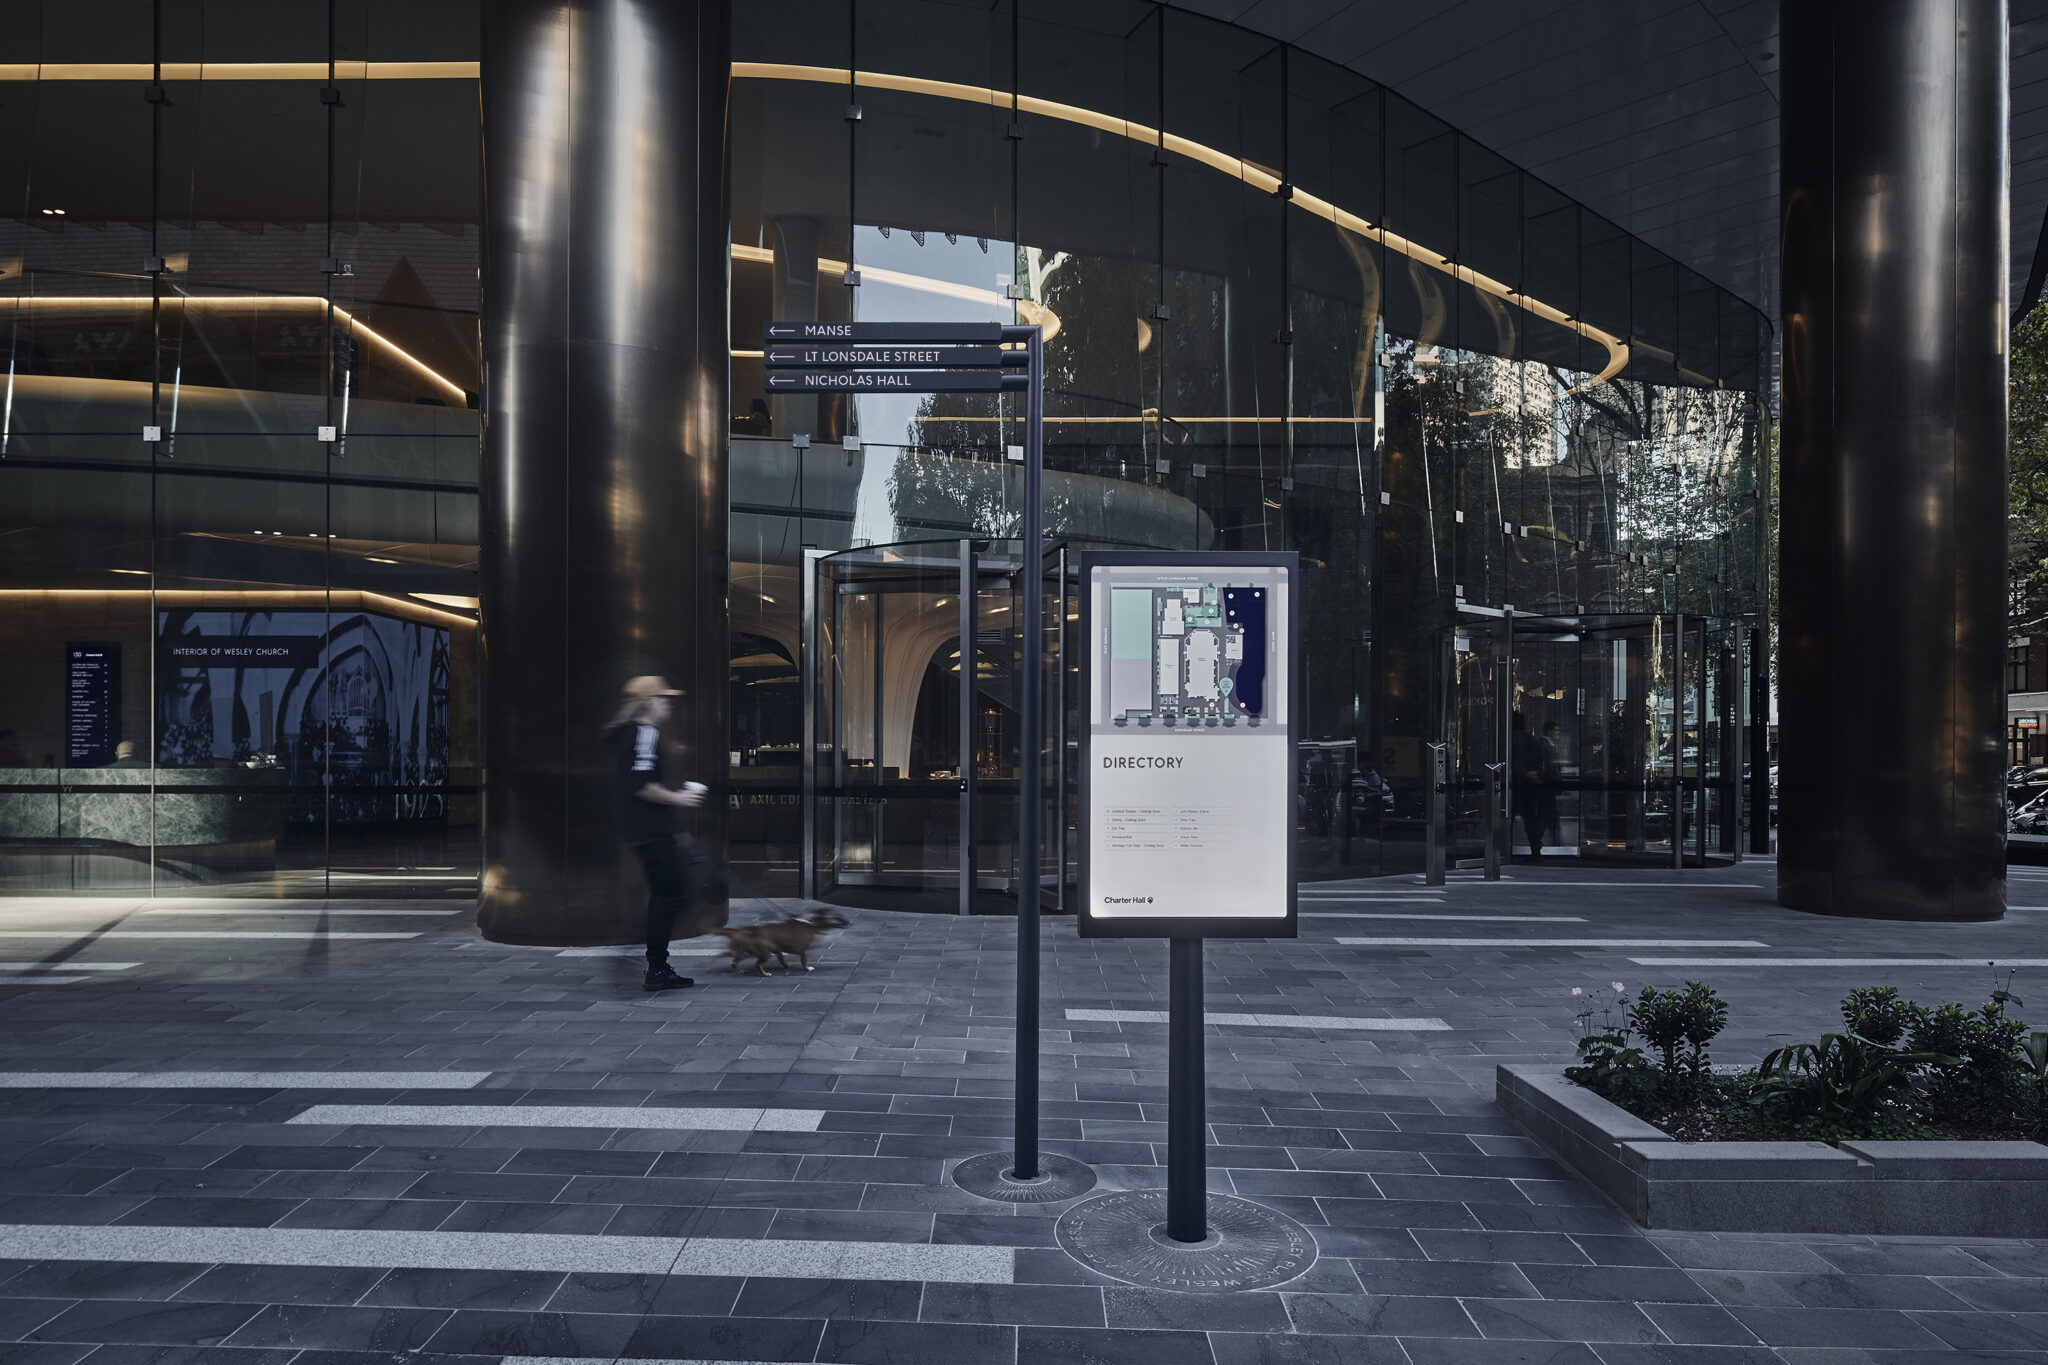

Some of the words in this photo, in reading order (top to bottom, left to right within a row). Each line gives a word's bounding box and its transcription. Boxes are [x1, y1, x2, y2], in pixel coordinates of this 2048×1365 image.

[805, 325, 852, 337] MANSE
[805, 350, 819, 363] LT
[822, 350, 890, 363] LONSDALE
[894, 350, 941, 363] STREET
[805, 374, 873, 387] NICHOLAS
[877, 374, 912, 387] HALL
[173, 647, 208, 656] INTERIOR
[210, 647, 222, 656] OF
[224, 647, 254, 656] WESLEY
[256, 647, 289, 656] CHURCH
[1103, 756, 1184, 769] DIRECTORY
[750, 794, 777, 806] AXIL
[1104, 896, 1132, 904] Charter
[1132, 896, 1146, 904] Hall
[1083, 1194, 1130, 1214] PLACE
[1225, 1200, 1278, 1224] PLACE
[1069, 1215, 1088, 1250] WESLEY
[1279, 1224, 1304, 1260] WESLEY
[1084, 1251, 1141, 1278] PLACE
[1245, 1260, 1296, 1283] PLACE
[1150, 1275, 1242, 1288] WESLEY
